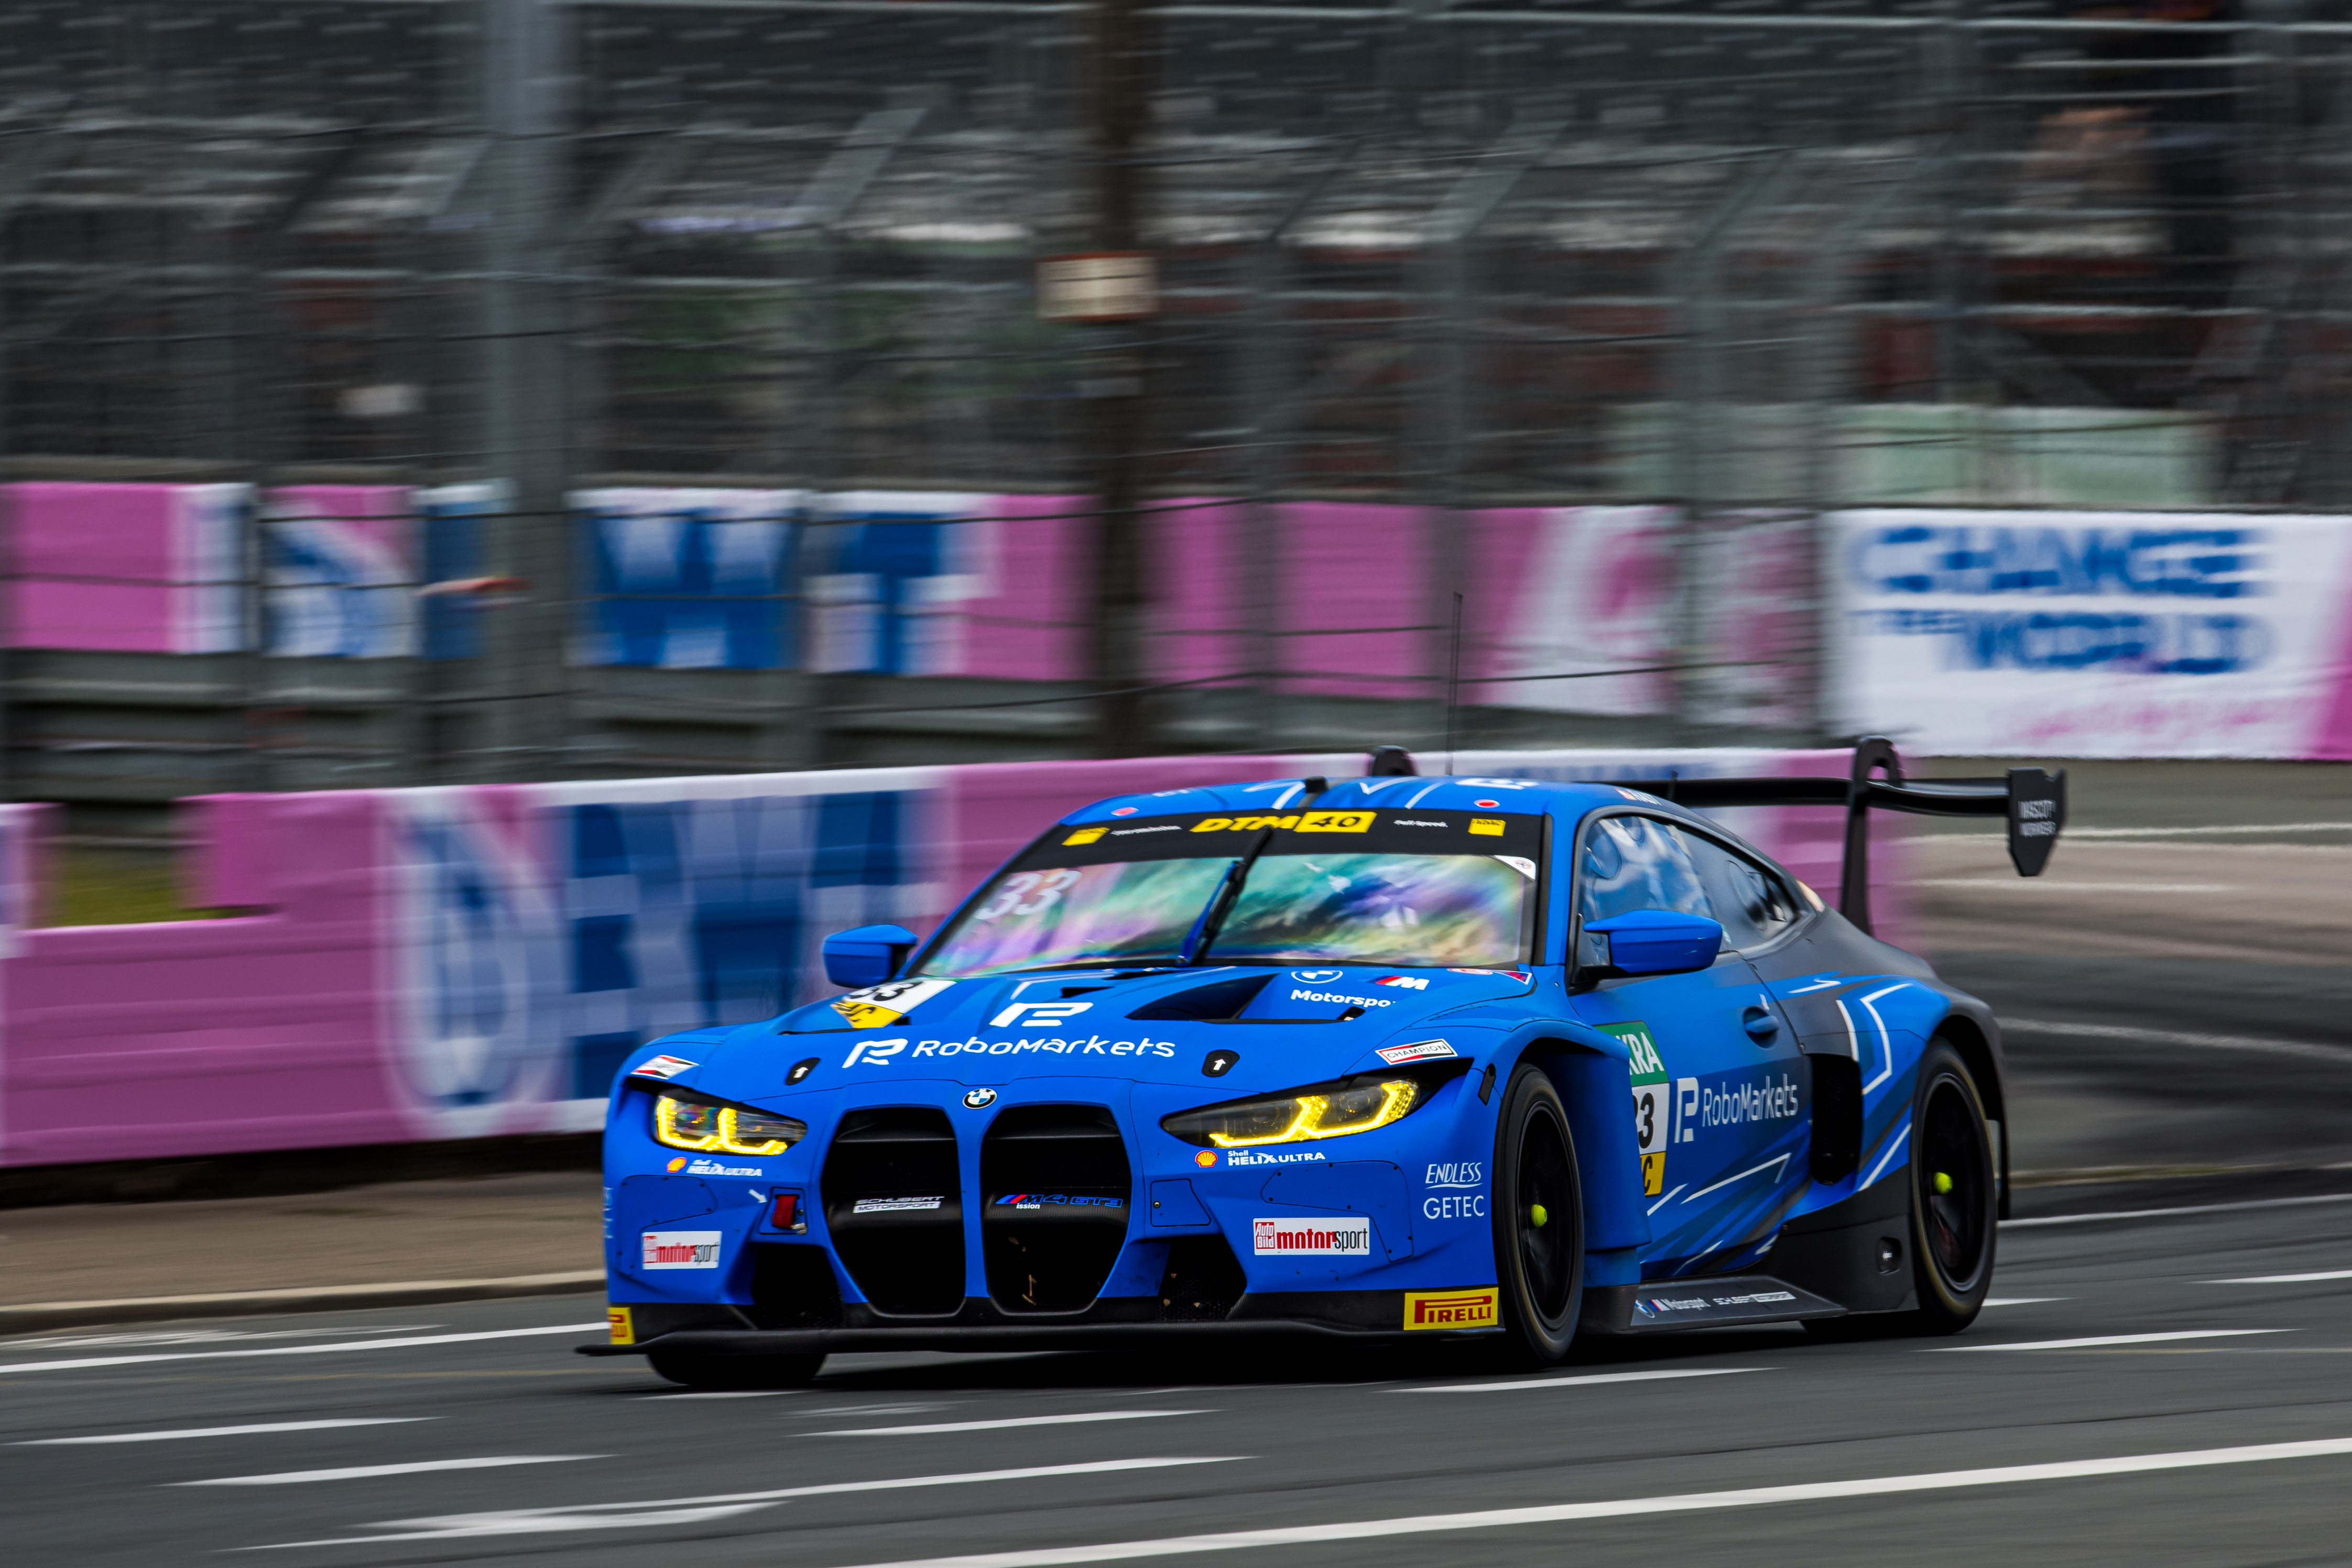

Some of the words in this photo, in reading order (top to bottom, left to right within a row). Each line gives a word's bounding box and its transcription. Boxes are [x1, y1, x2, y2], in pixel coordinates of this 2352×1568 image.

[1189, 815, 1302, 832] DTM
[1311, 816, 1362, 828] 40
[973, 870, 1083, 920] 33
[1290, 989, 1396, 1008] Motorspo
[911, 1035, 1176, 1058] RoboMarkets
[1387, 1044, 1447, 1058] CHAMPION
[1702, 1073, 1798, 1127] RoboMarkets
[1633, 1092, 1655, 1149] 3
[1228, 1152, 1278, 1166] HELIX
[1278, 1152, 1325, 1162] ULTRA
[1425, 1162, 1482, 1183] ENDLESS
[855, 1196, 945, 1205] SCHUBERT
[1423, 1195, 1484, 1219] GETEC
[1256, 1223, 1274, 1236] Auto
[1257, 1236, 1275, 1248] Bild
[1414, 1295, 1493, 1324] PIRELLI
